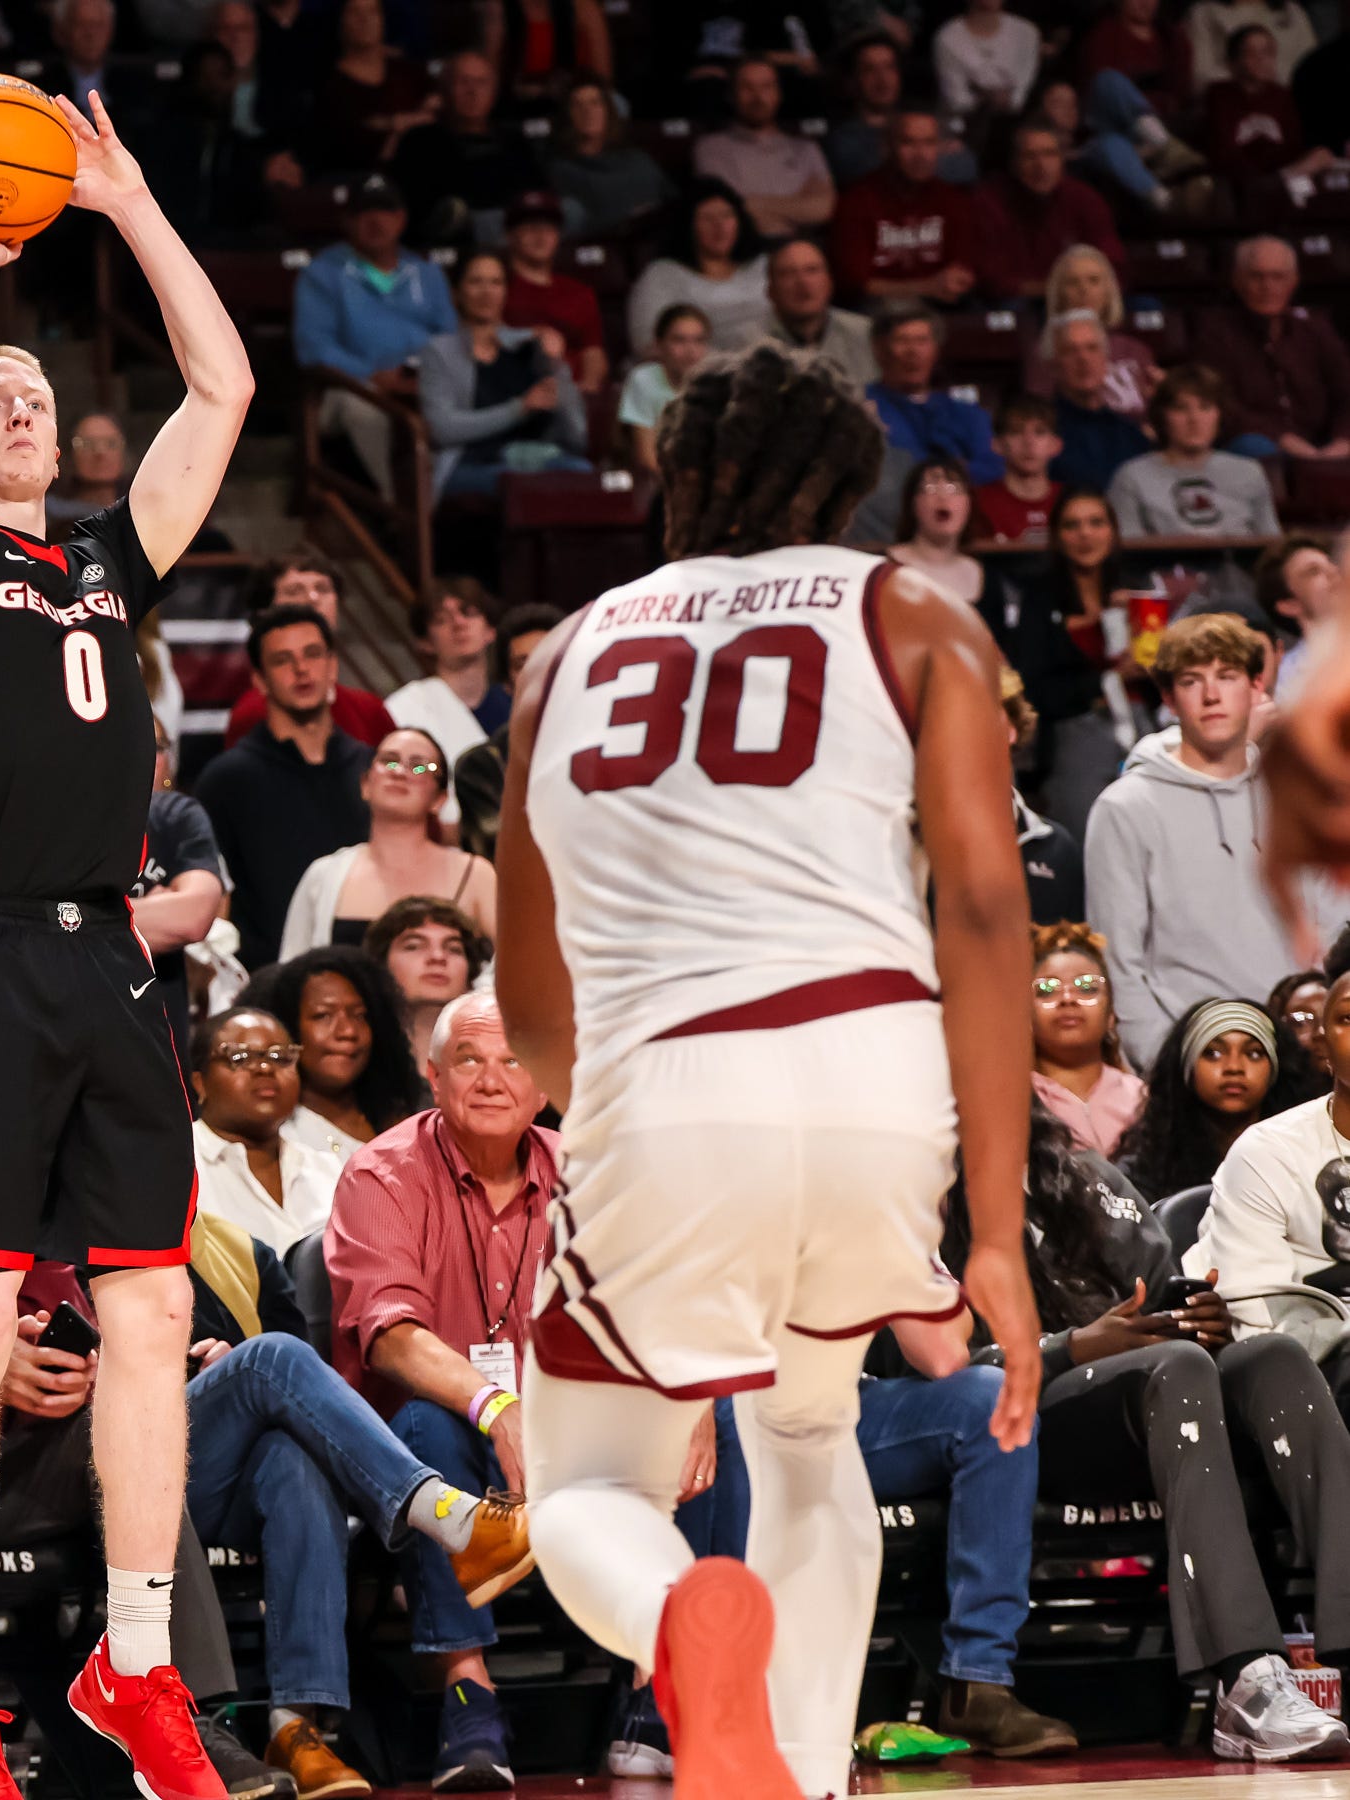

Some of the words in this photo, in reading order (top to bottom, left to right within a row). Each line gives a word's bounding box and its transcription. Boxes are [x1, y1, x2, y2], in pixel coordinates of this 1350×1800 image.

[83, 564, 104, 582] SEC
[595, 576, 849, 633] MURRAY-BOYLES
[62, 629, 109, 723] 0
[570, 624, 829, 796] 30
